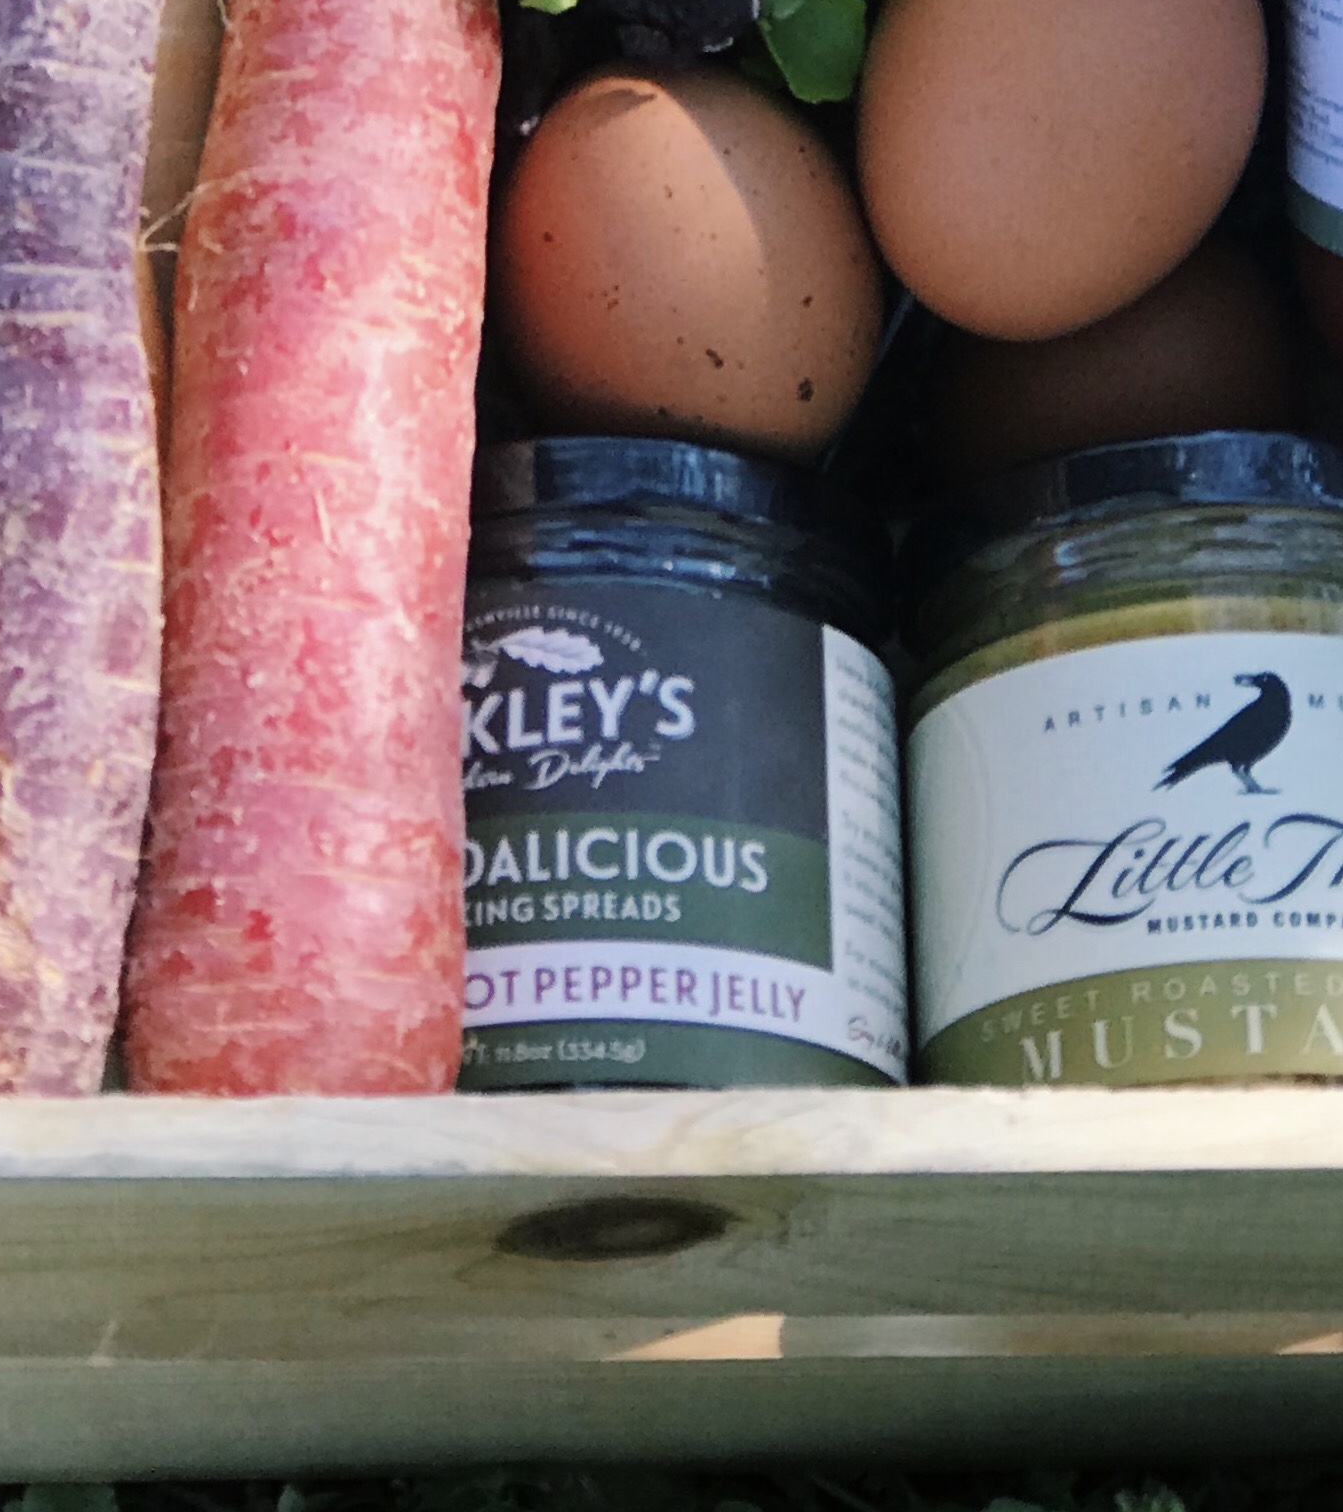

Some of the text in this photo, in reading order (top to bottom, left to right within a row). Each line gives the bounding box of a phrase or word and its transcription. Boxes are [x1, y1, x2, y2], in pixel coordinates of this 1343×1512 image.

[462, 667, 696, 758] KLEY'S
[1043, 692, 1212, 733] ARTISAN
[462, 826, 768, 893] DALICIOUS
[996, 817, 1254, 936] Little
[462, 888, 682, 927] ING SPREADS
[1147, 911, 1260, 934] MUSTARD
[463, 965, 806, 1022] OT PEPPER JELLY
[981, 990, 1099, 1042] SWEET
